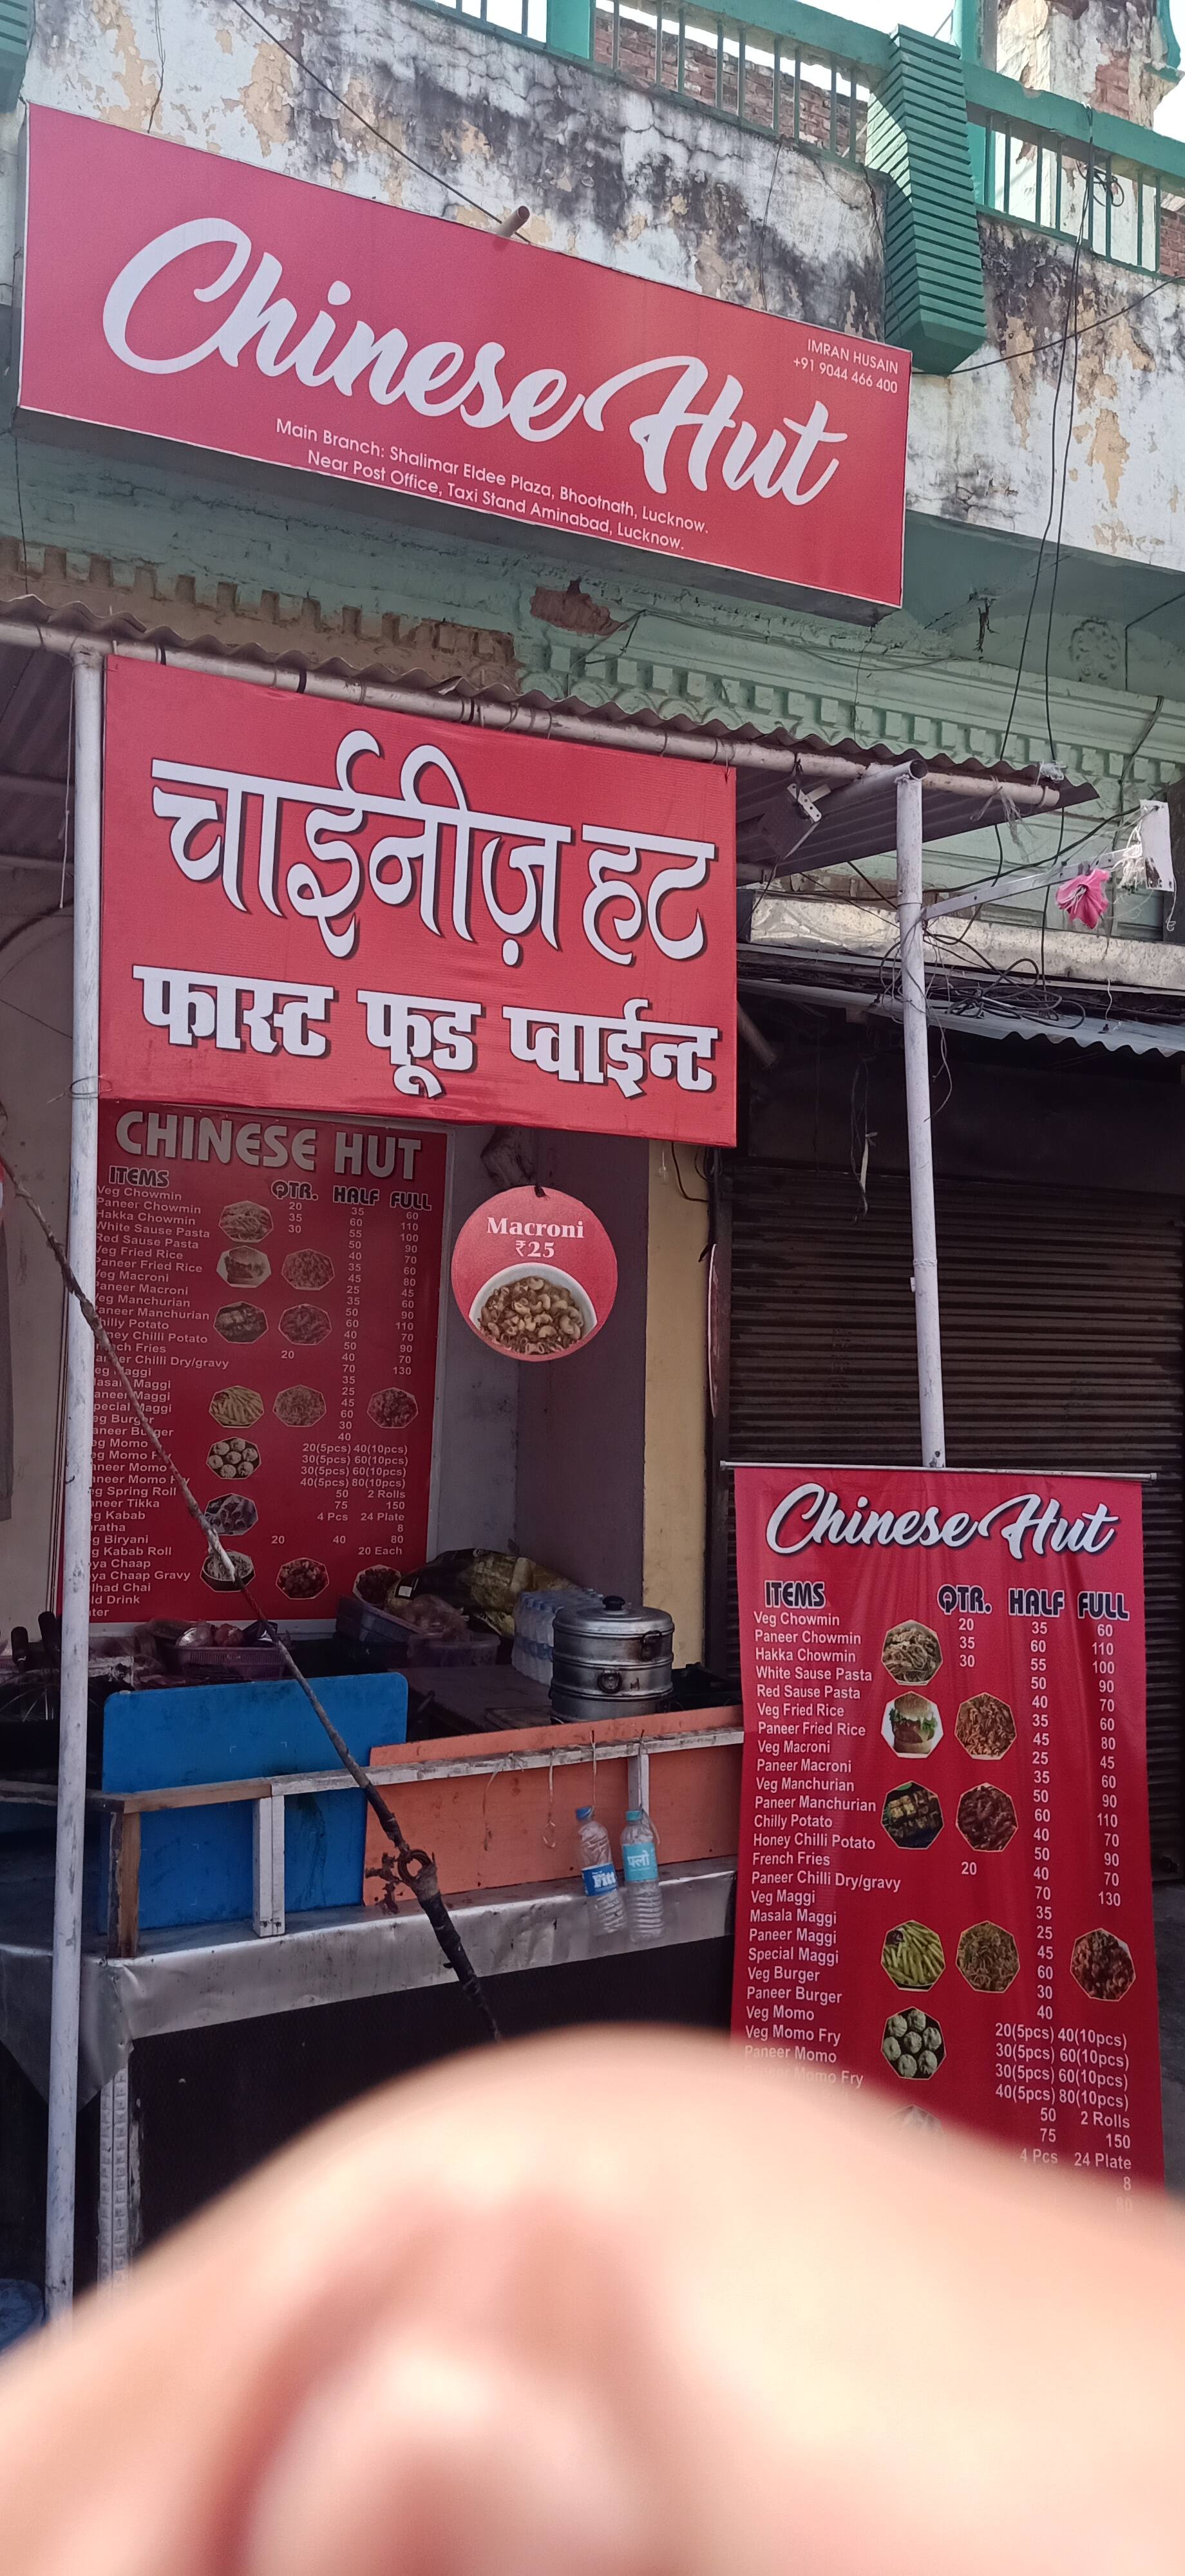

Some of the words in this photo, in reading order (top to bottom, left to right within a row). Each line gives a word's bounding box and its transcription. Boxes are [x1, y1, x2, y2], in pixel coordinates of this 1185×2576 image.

[102, 218, 585, 442] Chinese
[583, 356, 848, 506] Hut
[808, 339, 849, 361] IMRAN
[853, 351, 898, 374] HUSAIN
[793, 357, 814, 372] +91
[819, 363, 848, 381] 9044
[851, 372, 873, 387] 466
[876, 378, 898, 393] 400
[276, 418, 318, 442] Main
[323, 430, 385, 458] Branch:
[390, 446, 459, 475] Shalimar
[463, 464, 506, 486] Eldee
[511, 475, 555, 500] Plaza,
[560, 486, 638, 520] Bhootnath,
[642, 506, 708, 534] Lucknow.
[308, 450, 348, 472] Near
[353, 460, 386, 481] Post
[390, 470, 442, 497] Office,
[447, 482, 478, 502] Taxi
[482, 491, 526, 513] Stand
[530, 502, 612, 536] Aminabad,
[618, 522, 684, 550] Lucknow.
[152, 730, 572, 966] चाईनीज़
[582, 825, 716, 966] हट
[133, 965, 335, 1057] फास्ट
[357, 990, 482, 1098] फूड
[502, 999, 719, 1098] प्वाईन्ट
[116, 1112, 317, 1171] CHINESE
[334, 1132, 422, 1180] HUT
[109, 1166, 169, 1188] ITEMS
[271, 1180, 319, 1200] QTR.
[333, 1186, 380, 1206] HALF
[390, 1191, 432, 1211] FULL
[124, 1188, 182, 1201] Chowmin
[143, 1198, 201, 1214] Chowmin
[137, 1212, 196, 1226] Chowmin
[133, 1223, 173, 1235] Sause
[176, 1227, 210, 1238] Pasta
[486, 1217, 585, 1238] Macroni
[122, 1235, 161, 1246] Sause
[165, 1238, 199, 1249] Pasta
[515, 1240, 555, 1258] ₹25
[302, 1443, 351, 1455] 20(5pcs)
[353, 1444, 408, 1456] 40(10pcs)
[302, 1454, 351, 1466] 30(5pcs)
[354, 1455, 408, 1467] 60(10pcs)
[301, 1466, 350, 1477] 30(5pcs)
[352, 1466, 406, 1478] 60(10pcs)
[299, 1477, 349, 1489] 40(5pcs)
[351, 1478, 406, 1490] 80(10pcs)
[106, 1486, 149, 1498] Spring
[152, 1486, 176, 1496] Roll
[336, 1489, 349, 1499] 50
[367, 1489, 374, 1499] 2
[377, 1489, 406, 1499] Rolls
[126, 1498, 160, 1508] Tikka
[334, 1501, 348, 1510] 75
[386, 1501, 405, 1510] 150
[106, 1510, 146, 1520] Kabab
[317, 1512, 324, 1521] 4
[327, 1512, 348, 1521] Pcs
[360, 1512, 374, 1521] 24
[377, 1512, 405, 1521] Plate
[766, 1483, 980, 1555] Chinese
[978, 1493, 1119, 1560] Hut
[397, 1524, 404, 1533] 8
[104, 1534, 149, 1546] Biryani
[271, 1535, 285, 1544] 20
[332, 1535, 346, 1544] 40
[390, 1535, 404, 1544] 80
[103, 1546, 144, 1556] Kabab
[147, 1546, 172, 1556] Roll
[357, 1546, 372, 1555] 20
[374, 1546, 403, 1555] Each
[111, 1558, 151, 1570] Chaap
[110, 1571, 151, 1582] Chaap
[154, 1570, 191, 1582] Gravy
[122, 1582, 151, 1592] Chai
[106, 1595, 140, 1604] Drink
[764, 1580, 826, 1609] ITEMS
[936, 1584, 992, 1616] QTR.
[1008, 1588, 1065, 1618] HALF
[1077, 1591, 1130, 1621] FULL
[753, 1611, 777, 1628] Veg
[780, 1611, 840, 1626] Chowmin
[958, 1617, 974, 1631] 20
[1031, 1621, 1048, 1634] 35
[1097, 1623, 1114, 1638] 60
[755, 1629, 799, 1643] Paneer
[802, 1630, 861, 1645] Chowmin
[959, 1636, 975, 1649] 35
[1030, 1639, 1047, 1653] 60
[1092, 1642, 1114, 1656] 110
[755, 1647, 793, 1662] Hakka
[797, 1647, 856, 1663] Chowmin
[959, 1654, 975, 1668] 30
[755, 1665, 791, 1680] White
[795, 1665, 832, 1680] Sause
[836, 1667, 873, 1681] Pasta
[1030, 1658, 1047, 1673] 55
[1092, 1660, 1115, 1674] 100
[1030, 1676, 1047, 1690] 50
[1099, 1679, 1115, 1693] 90
[757, 1683, 781, 1698] Red
[784, 1684, 821, 1698] Sause
[824, 1685, 860, 1700] Pasta
[1031, 1694, 1048, 1709] 40
[1099, 1698, 1115, 1712] 70
[757, 1702, 780, 1719] Veg
[783, 1702, 813, 1716] Fried
[817, 1703, 844, 1717] Rice
[1032, 1713, 1048, 1728] 35
[1099, 1717, 1115, 1732] 60
[758, 1721, 801, 1735] Paneer
[802, 1721, 833, 1735] Fried
[837, 1722, 866, 1736] Rice
[1032, 1732, 1050, 1747] 45
[1101, 1736, 1116, 1750] 80
[757, 1739, 780, 1757] Veg
[783, 1739, 830, 1754] Macroni
[1032, 1750, 1049, 1765] 25
[1099, 1755, 1115, 1770] 45
[757, 1758, 799, 1772] Paneer
[801, 1758, 851, 1773] Macroni
[755, 1776, 778, 1794] Veg
[781, 1776, 855, 1792] Manchurian
[755, 1795, 797, 1809] Paneer
[799, 1795, 877, 1812] Manchurian
[754, 1814, 788, 1831] Chilly
[790, 1814, 833, 1828] Potato
[753, 1833, 792, 1849] Honey
[794, 1832, 828, 1847] Chilli
[831, 1833, 876, 1850] Potato
[752, 1851, 793, 1866] French
[797, 1851, 830, 1866] Fries
[752, 1871, 794, 1884] Paneer
[797, 1870, 831, 1886] Chilli
[835, 1872, 901, 1893] Dry/gravy
[750, 1889, 773, 1906] Veg
[776, 1889, 815, 1907] Maggi
[750, 1908, 792, 1922] Masala
[796, 1908, 837, 1927] Maggi
[748, 1946, 794, 1964] Special
[798, 1947, 839, 1967] Maggi
[747, 1966, 770, 1983] Veg
[773, 1965, 820, 1984] Burger
[995, 2083, 1056, 2106] 40(5pcs)
[1059, 2088, 1129, 2112] 80(10pcs)
[1080, 2110, 1089, 2125] 2
[1092, 2110, 1130, 2129] Rolls
